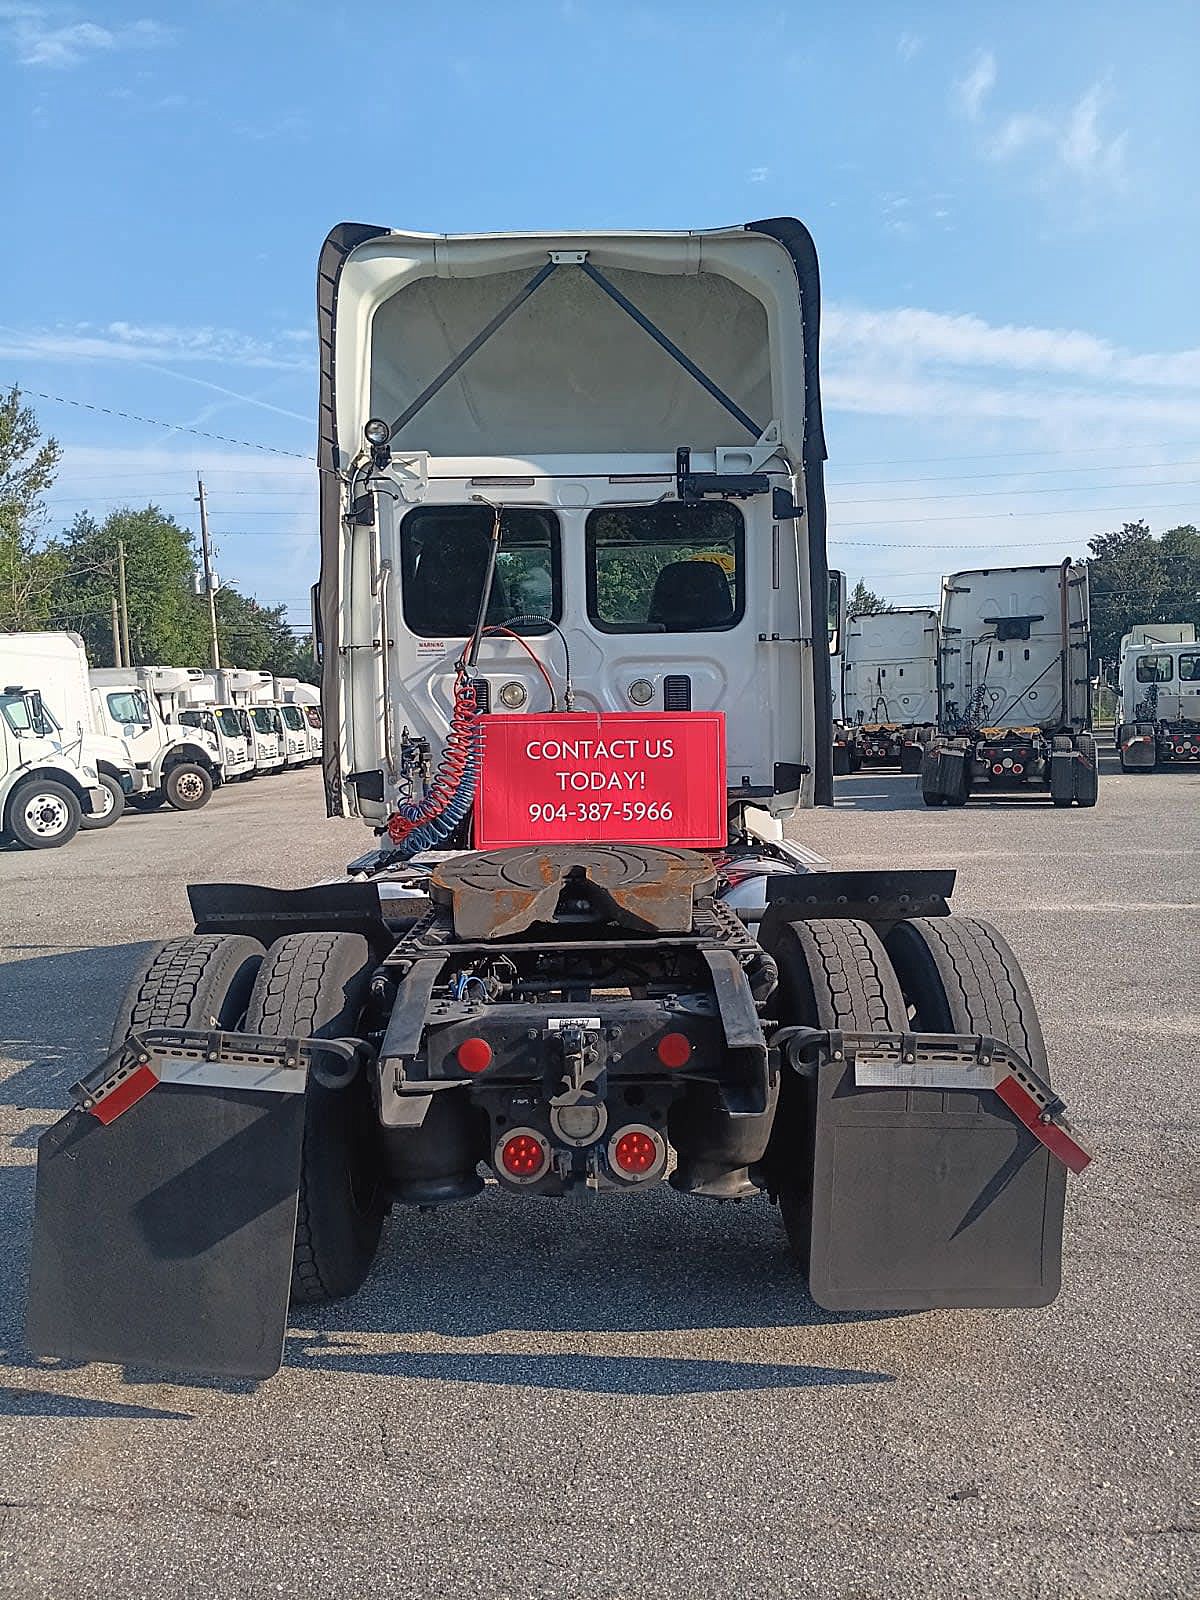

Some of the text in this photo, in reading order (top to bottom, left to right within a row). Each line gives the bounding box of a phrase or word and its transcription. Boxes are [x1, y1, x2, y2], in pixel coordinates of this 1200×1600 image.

[526, 739, 674, 760] CONTACT US
[555, 771, 646, 791] TODAY!
[528, 801, 673, 822] 904-387-5966
